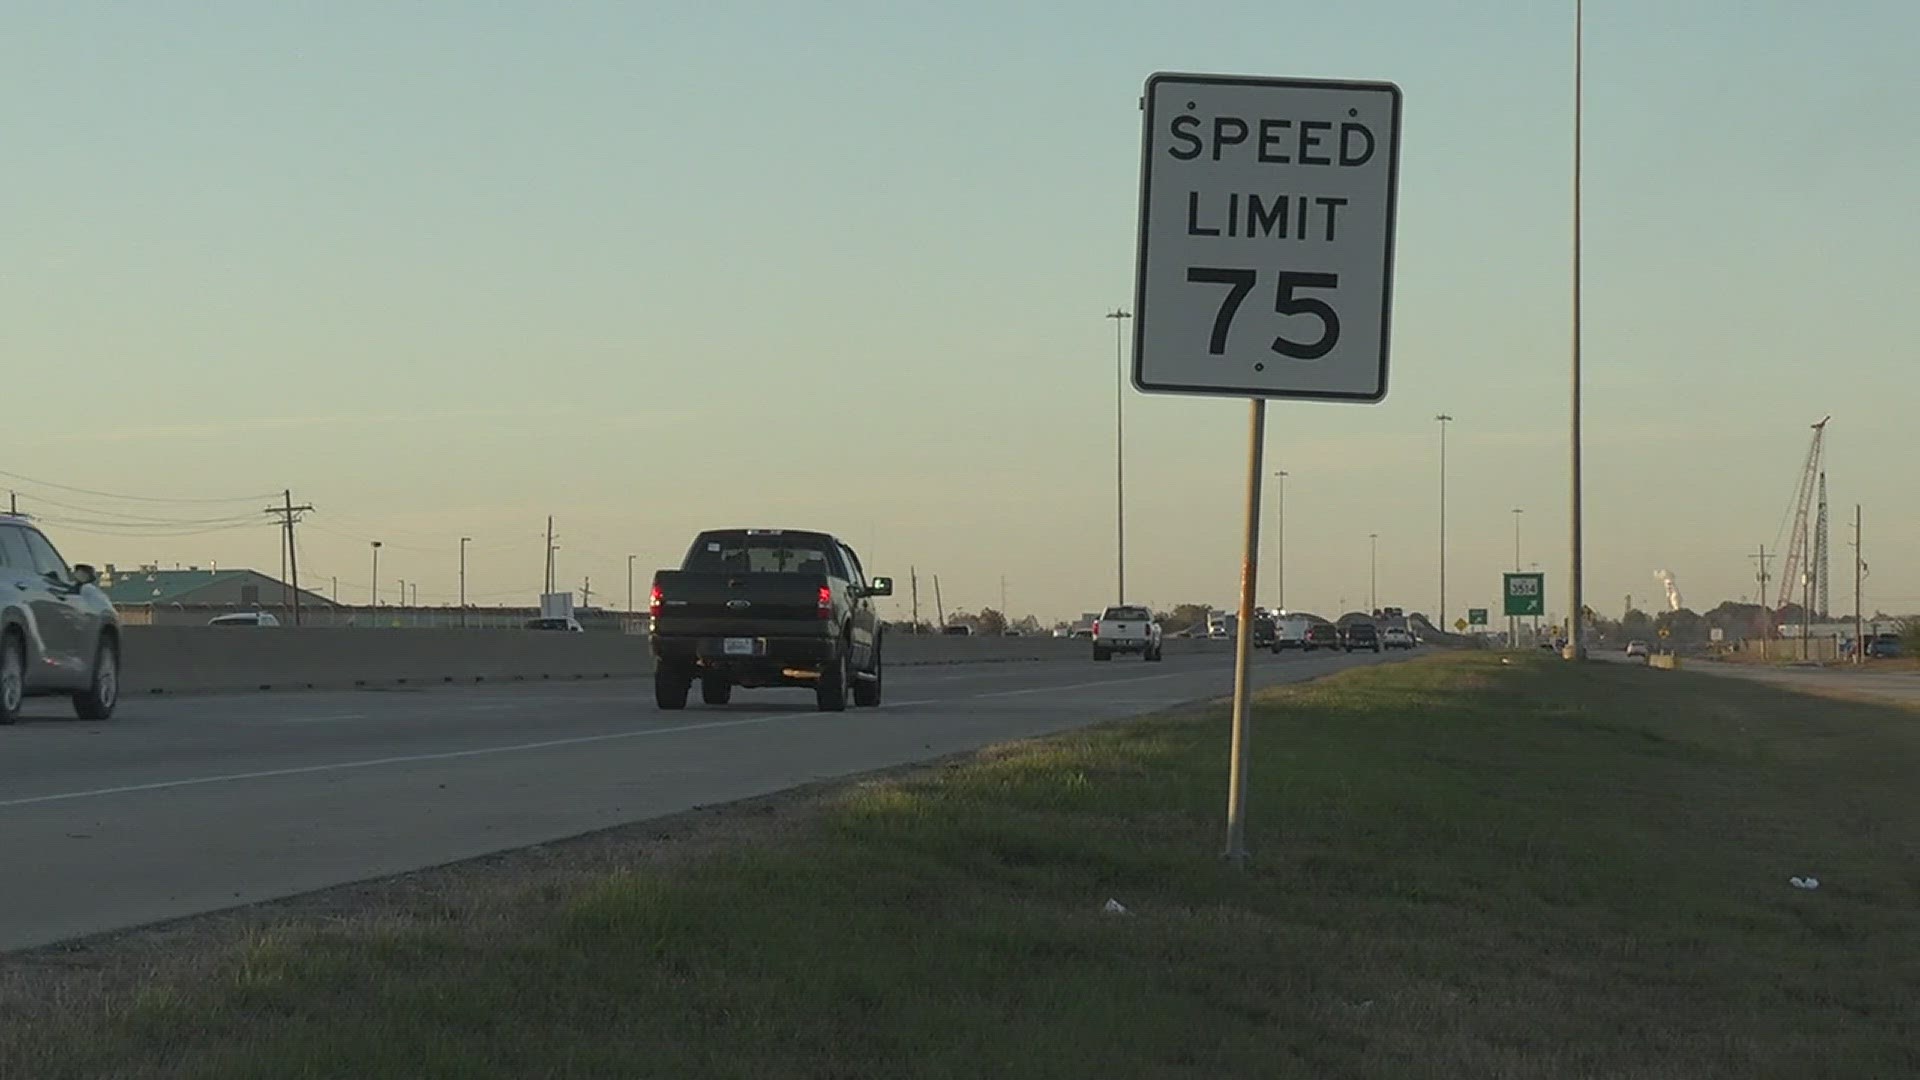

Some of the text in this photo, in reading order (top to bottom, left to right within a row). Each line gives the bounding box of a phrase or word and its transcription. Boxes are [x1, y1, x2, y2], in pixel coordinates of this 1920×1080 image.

[1168, 115, 1375, 167] SPEED
[1187, 191, 1348, 242] LIMIT
[1186, 267, 1341, 360] 75
